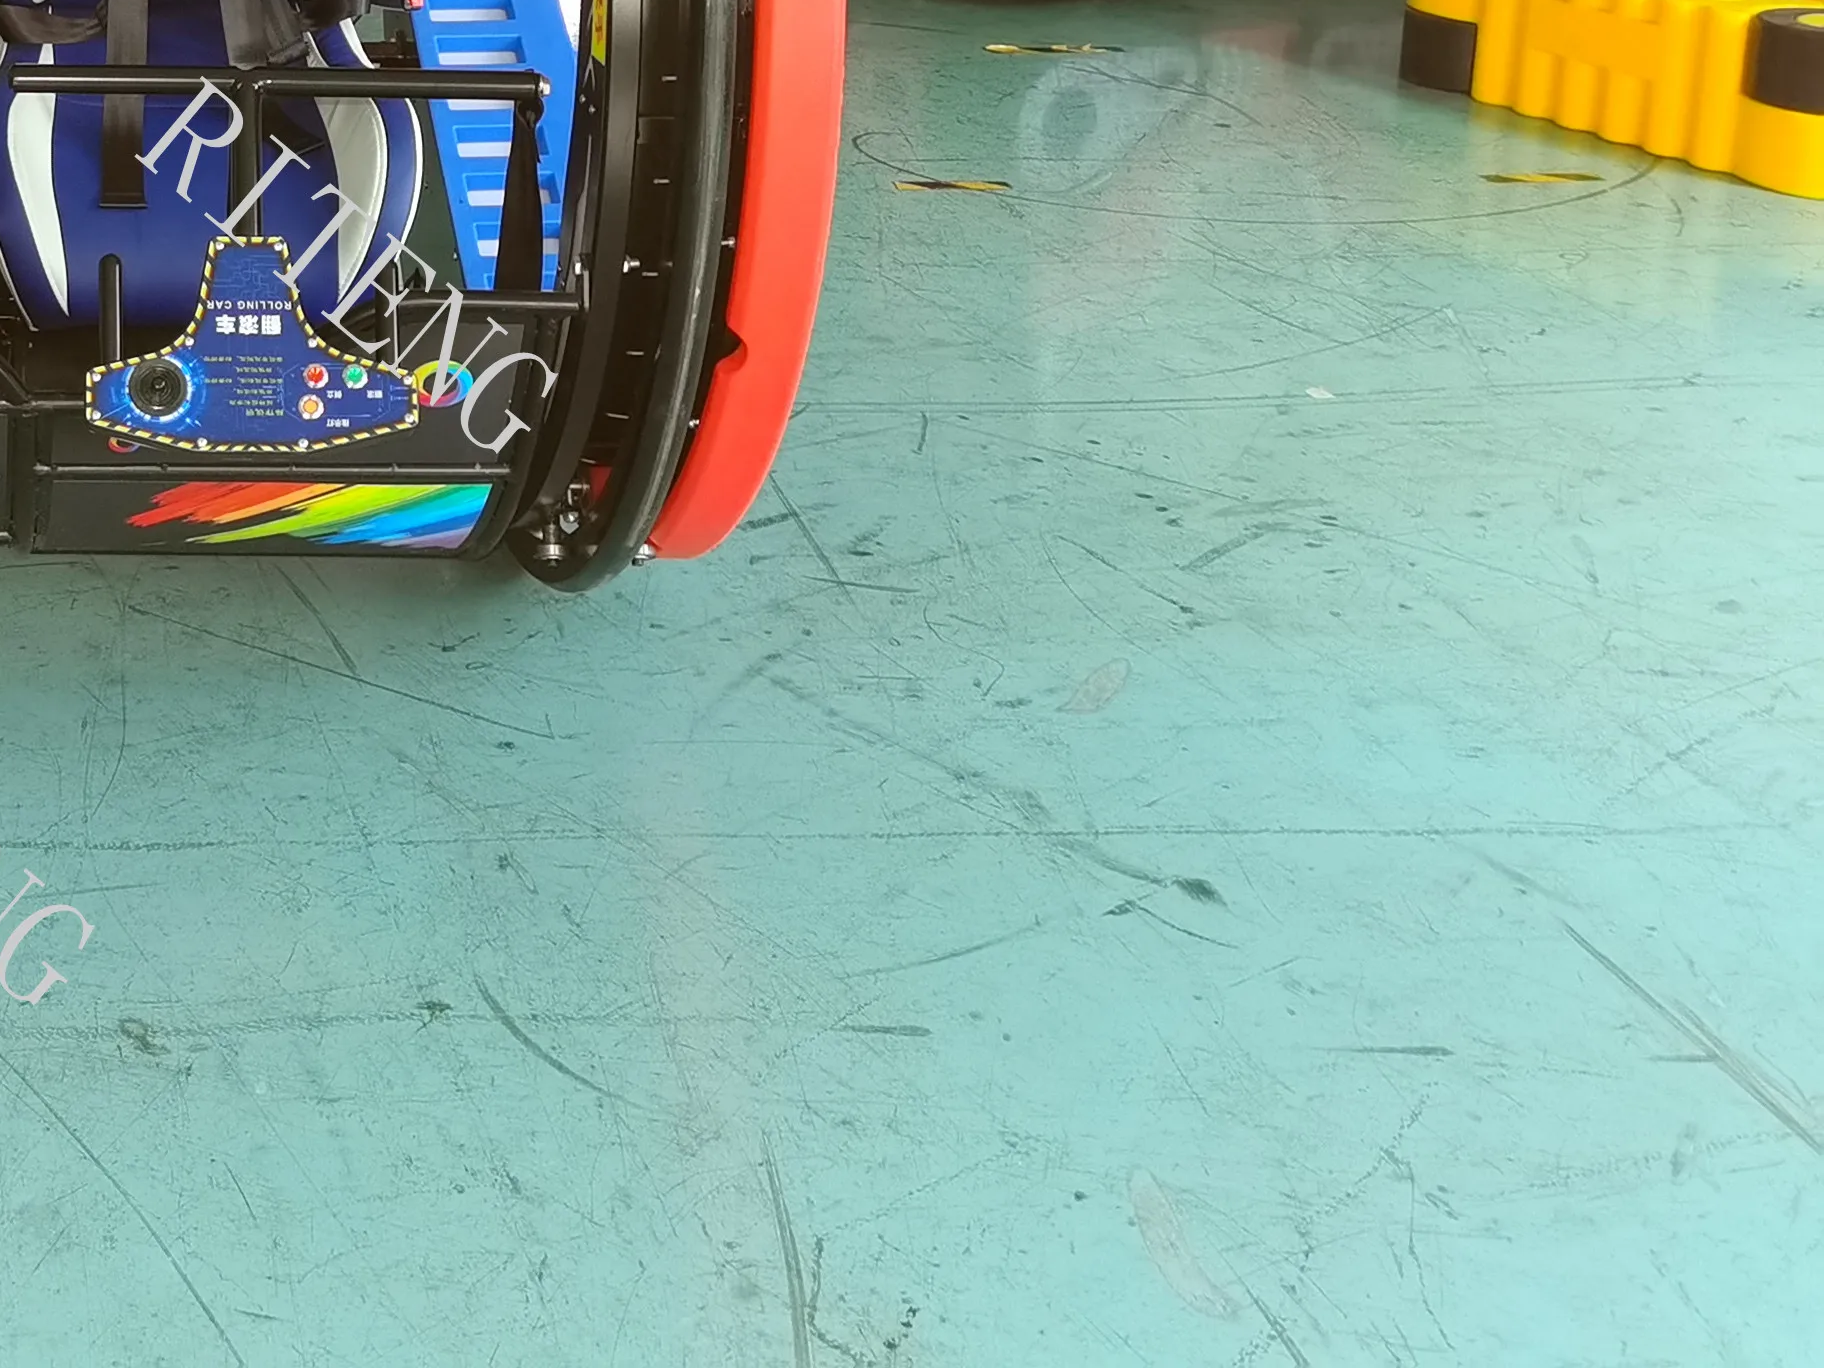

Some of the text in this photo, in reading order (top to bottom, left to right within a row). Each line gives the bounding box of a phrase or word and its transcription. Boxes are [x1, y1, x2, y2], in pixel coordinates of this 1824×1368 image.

[207, 300, 292, 311] ROLLING CAR
[215, 314, 282, 335] 翻滚车
